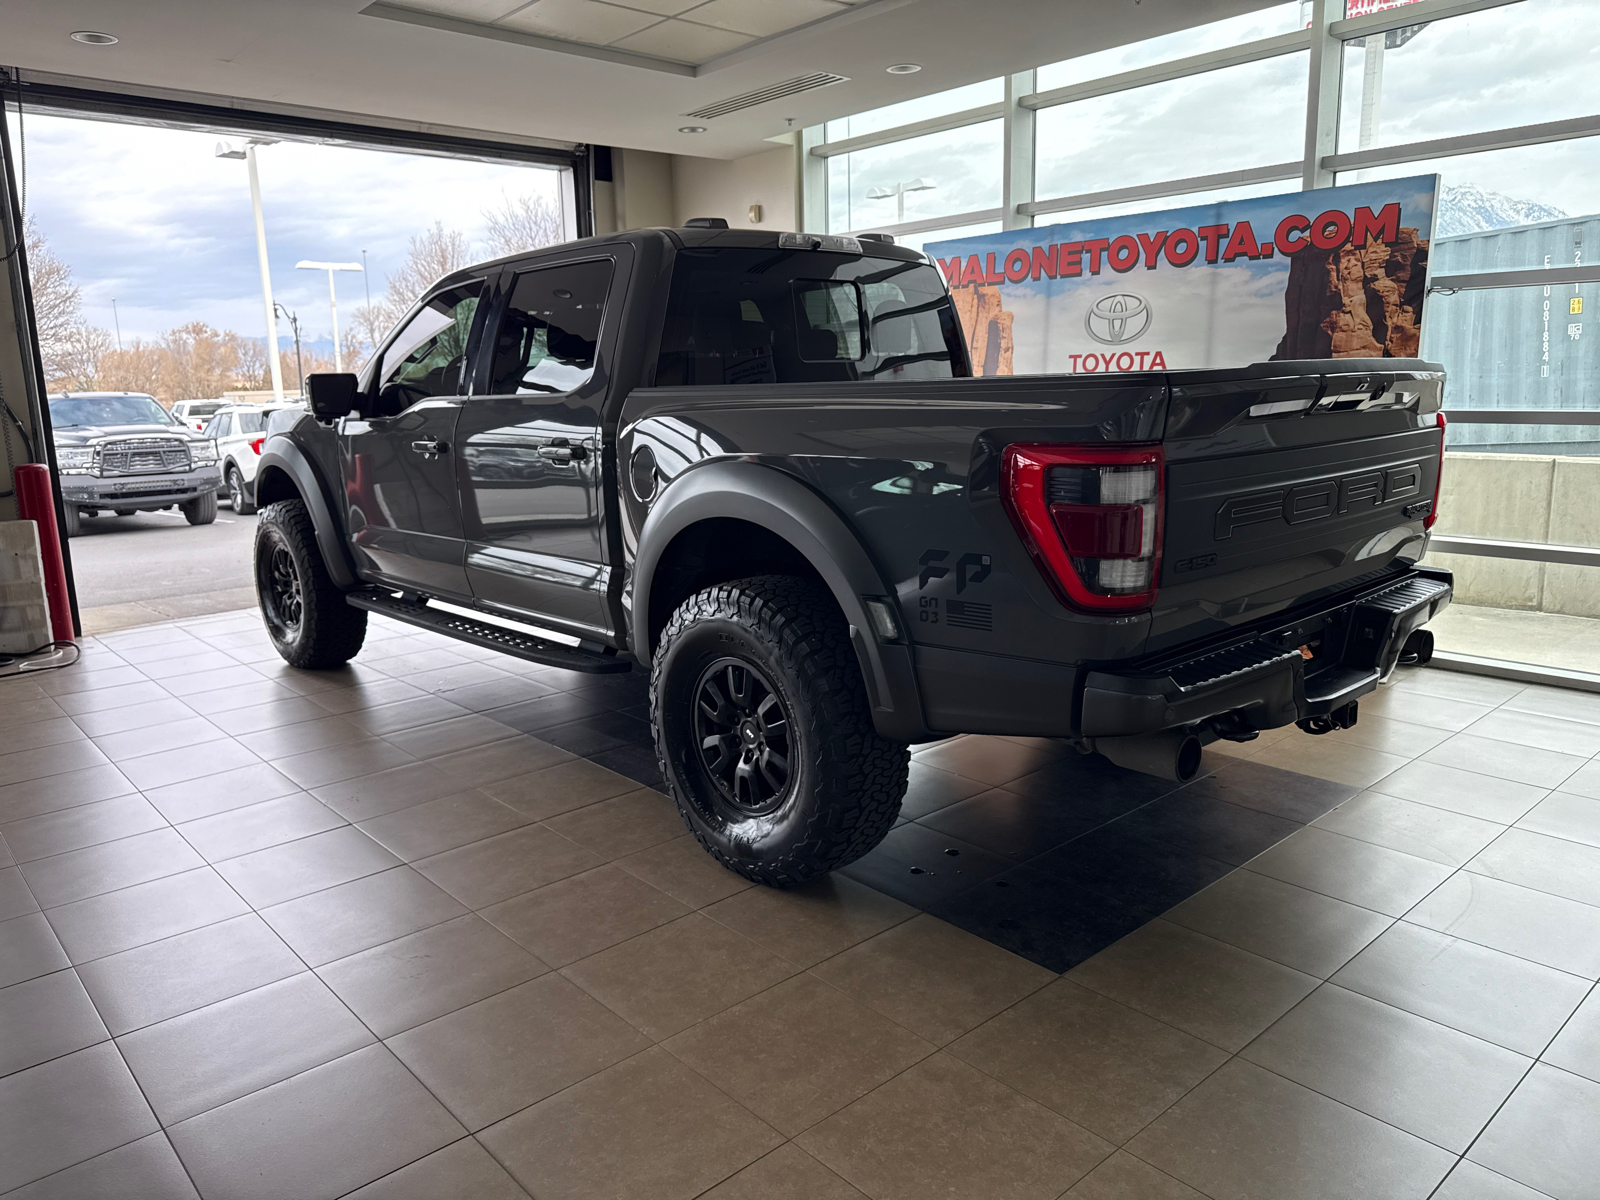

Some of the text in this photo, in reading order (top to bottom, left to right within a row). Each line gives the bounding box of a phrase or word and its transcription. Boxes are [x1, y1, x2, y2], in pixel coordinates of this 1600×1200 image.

[937, 202, 1402, 289] MALONETOYOTA.COM
[1068, 351, 1167, 373] TOYOTA
[1213, 463, 1422, 541] FORD
